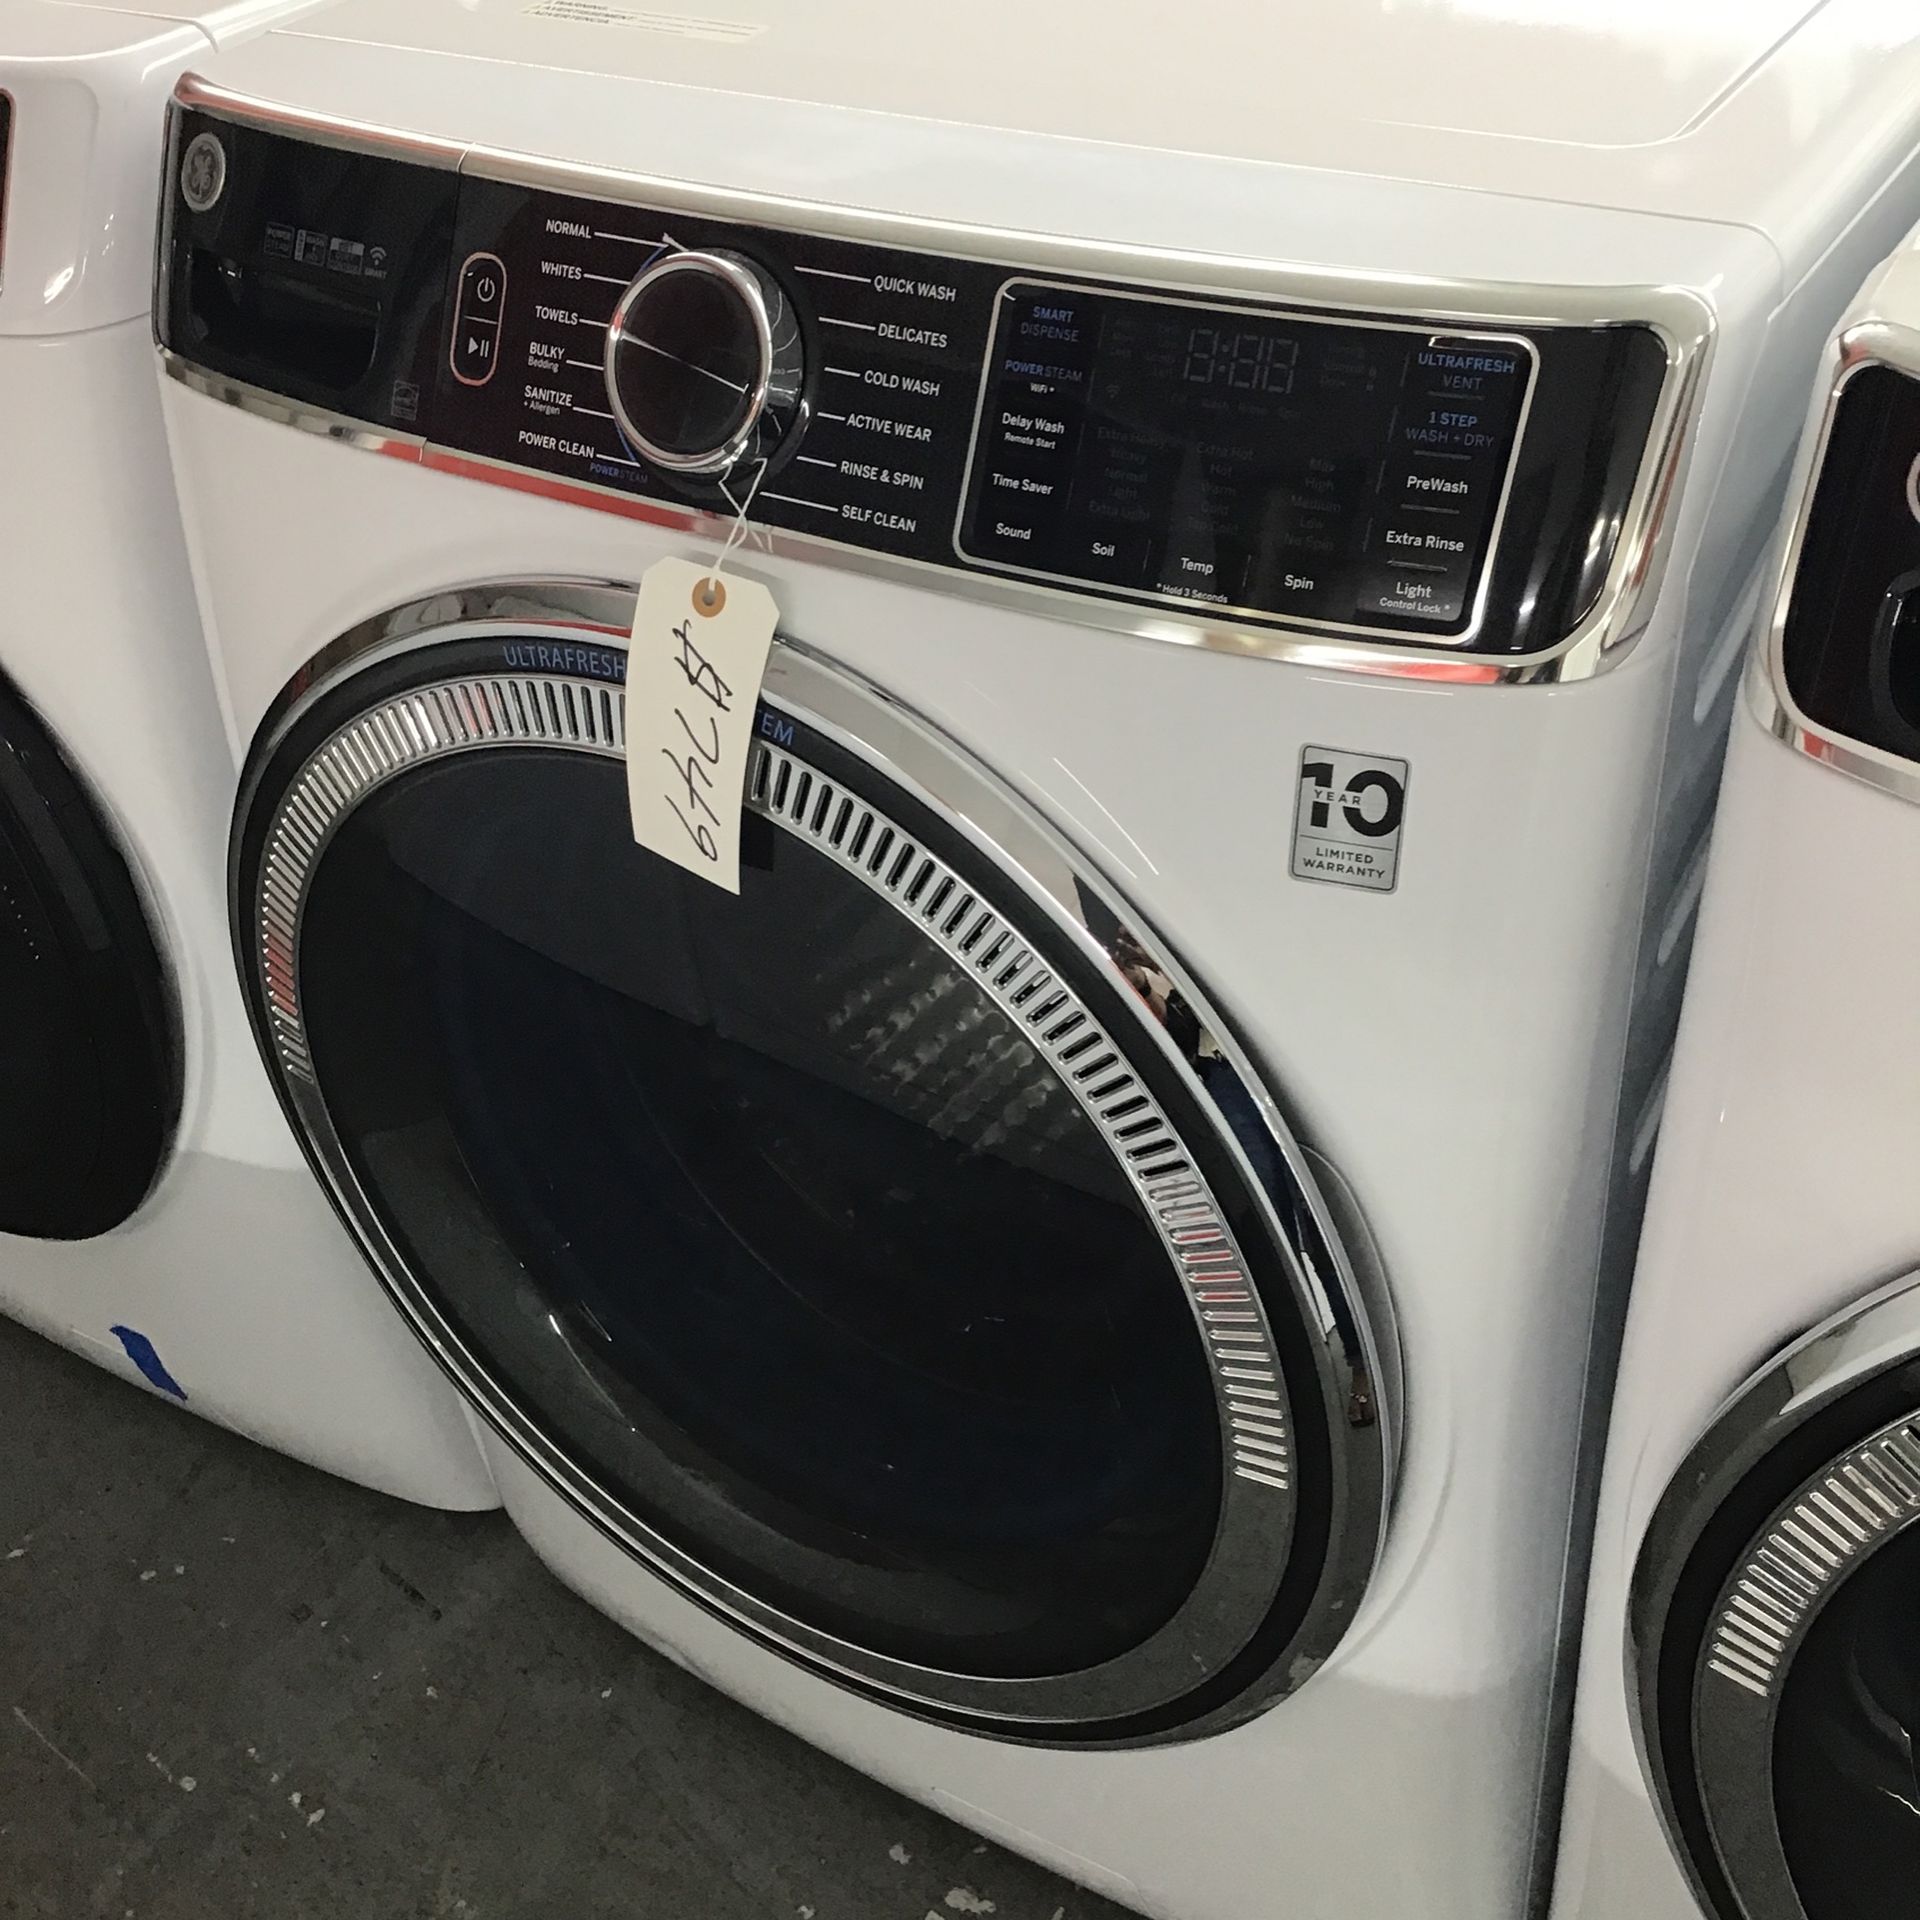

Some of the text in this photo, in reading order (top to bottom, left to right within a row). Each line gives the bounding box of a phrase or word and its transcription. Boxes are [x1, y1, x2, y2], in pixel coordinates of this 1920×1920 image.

[545, 219, 592, 239] NORMAL
[541, 261, 582, 280] WHITES
[874, 275, 956, 302] QUICK WASH
[535, 305, 578, 325] TOWELS
[1032, 306, 1074, 324] SMART
[877, 322, 948, 348] DELICATES
[1020, 322, 1080, 342] DISPENSE
[529, 341, 565, 360] BULKY
[528, 356, 559, 373] Bedding
[1418, 352, 1515, 375] ULTRAFRESH
[864, 370, 940, 397] COLD WASH
[1442, 375, 1483, 391] VENT
[524, 385, 573, 407] SANITIZE
[529, 400, 561, 415] Allergen
[847, 413, 932, 442] ACTIVE WEAR
[1002, 412, 1066, 435] Delay Wash
[1428, 411, 1478, 428] 1 STEP
[518, 430, 595, 459] POWER CLEAN
[1004, 432, 1056, 450] Remote Start
[1406, 428, 1450, 444] WASH
[1463, 433, 1495, 448] DRY
[840, 460, 924, 490] RINSE & SPIN
[992, 473, 1054, 495] Time Saver
[1407, 476, 1469, 494] PreWash
[842, 504, 916, 533] SELF CLEAN
[995, 522, 1031, 540] Sound
[1092, 542, 1116, 557] Soil
[1385, 530, 1465, 553] Extra Rinse
[1180, 556, 1214, 576] Temp
[1284, 574, 1314, 591] Spin
[1396, 581, 1432, 599] Light
[1183, 587, 1190, 597] 3
[1191, 589, 1228, 603] Seconds
[1380, 597, 1441, 613] Control Lock
[503, 645, 626, 679] ULTRAFRESH
[1302, 762, 1405, 837] 10
[1314, 789, 1362, 805] YEAR
[1316, 847, 1374, 864] LIMITED
[1302, 858, 1386, 879] WARRANTY
